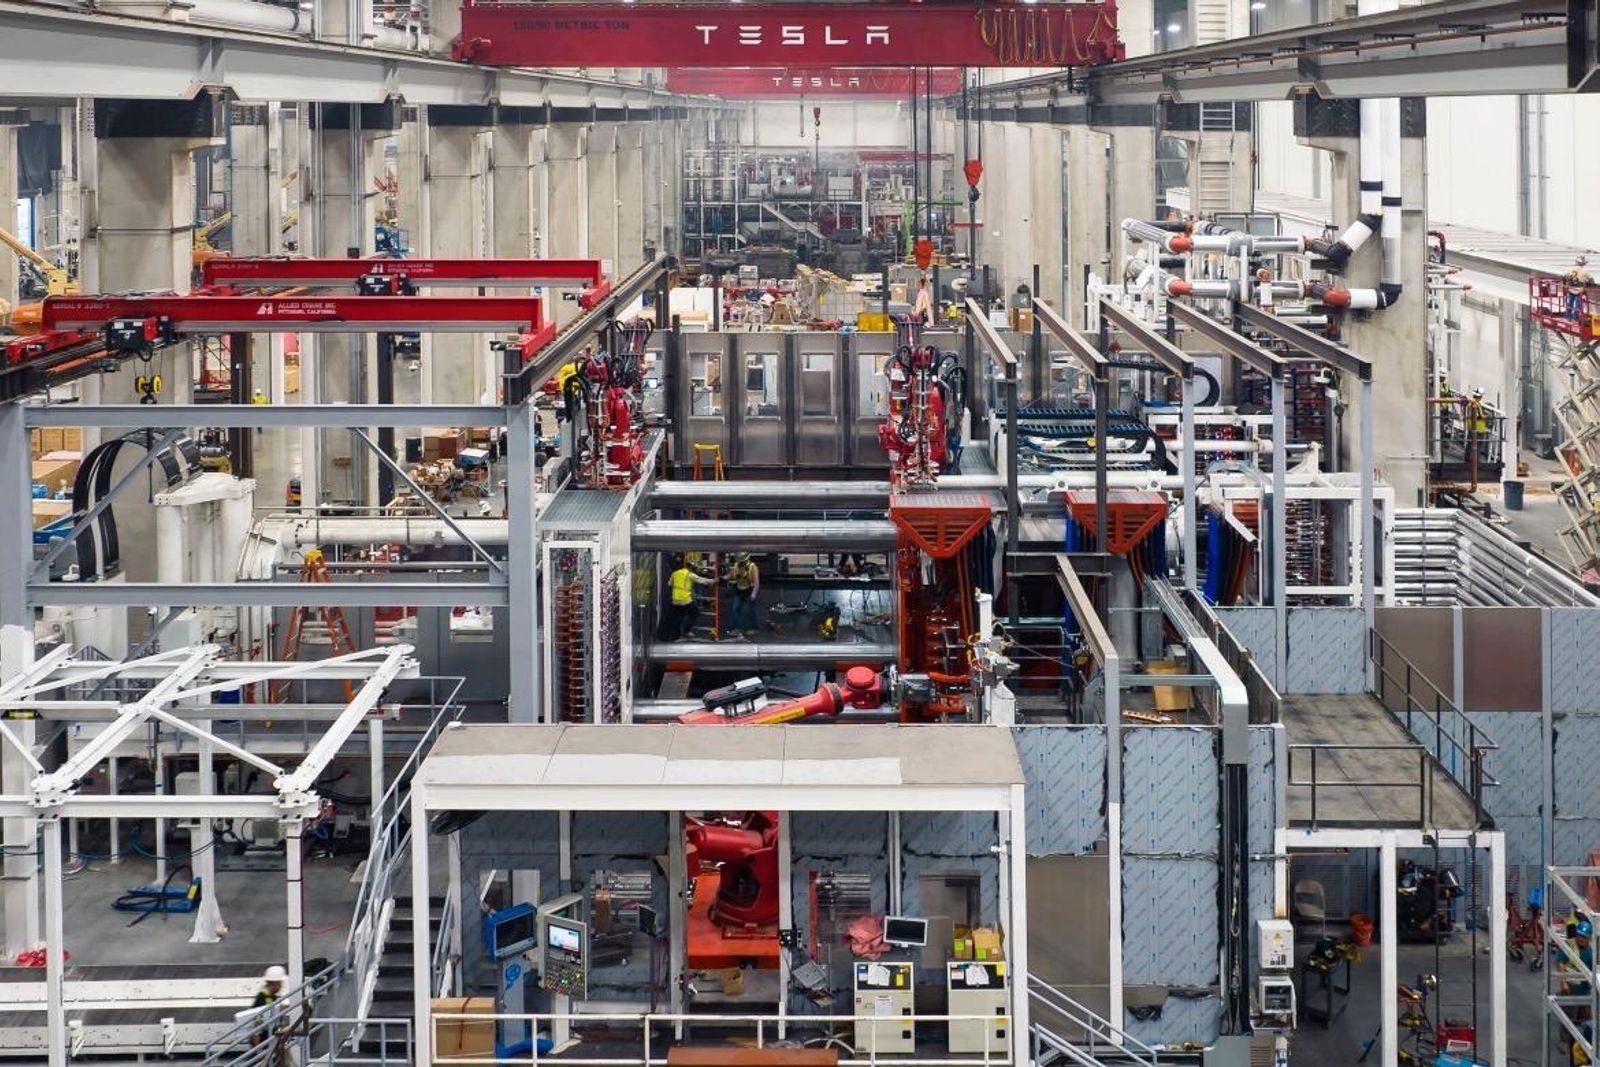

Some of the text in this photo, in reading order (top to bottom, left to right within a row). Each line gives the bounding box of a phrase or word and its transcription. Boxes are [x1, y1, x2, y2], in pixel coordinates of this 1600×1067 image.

[604, 20, 630, 29] TON
[695, 25, 890, 45] TESLA
[771, 77, 860, 87] TESLA
